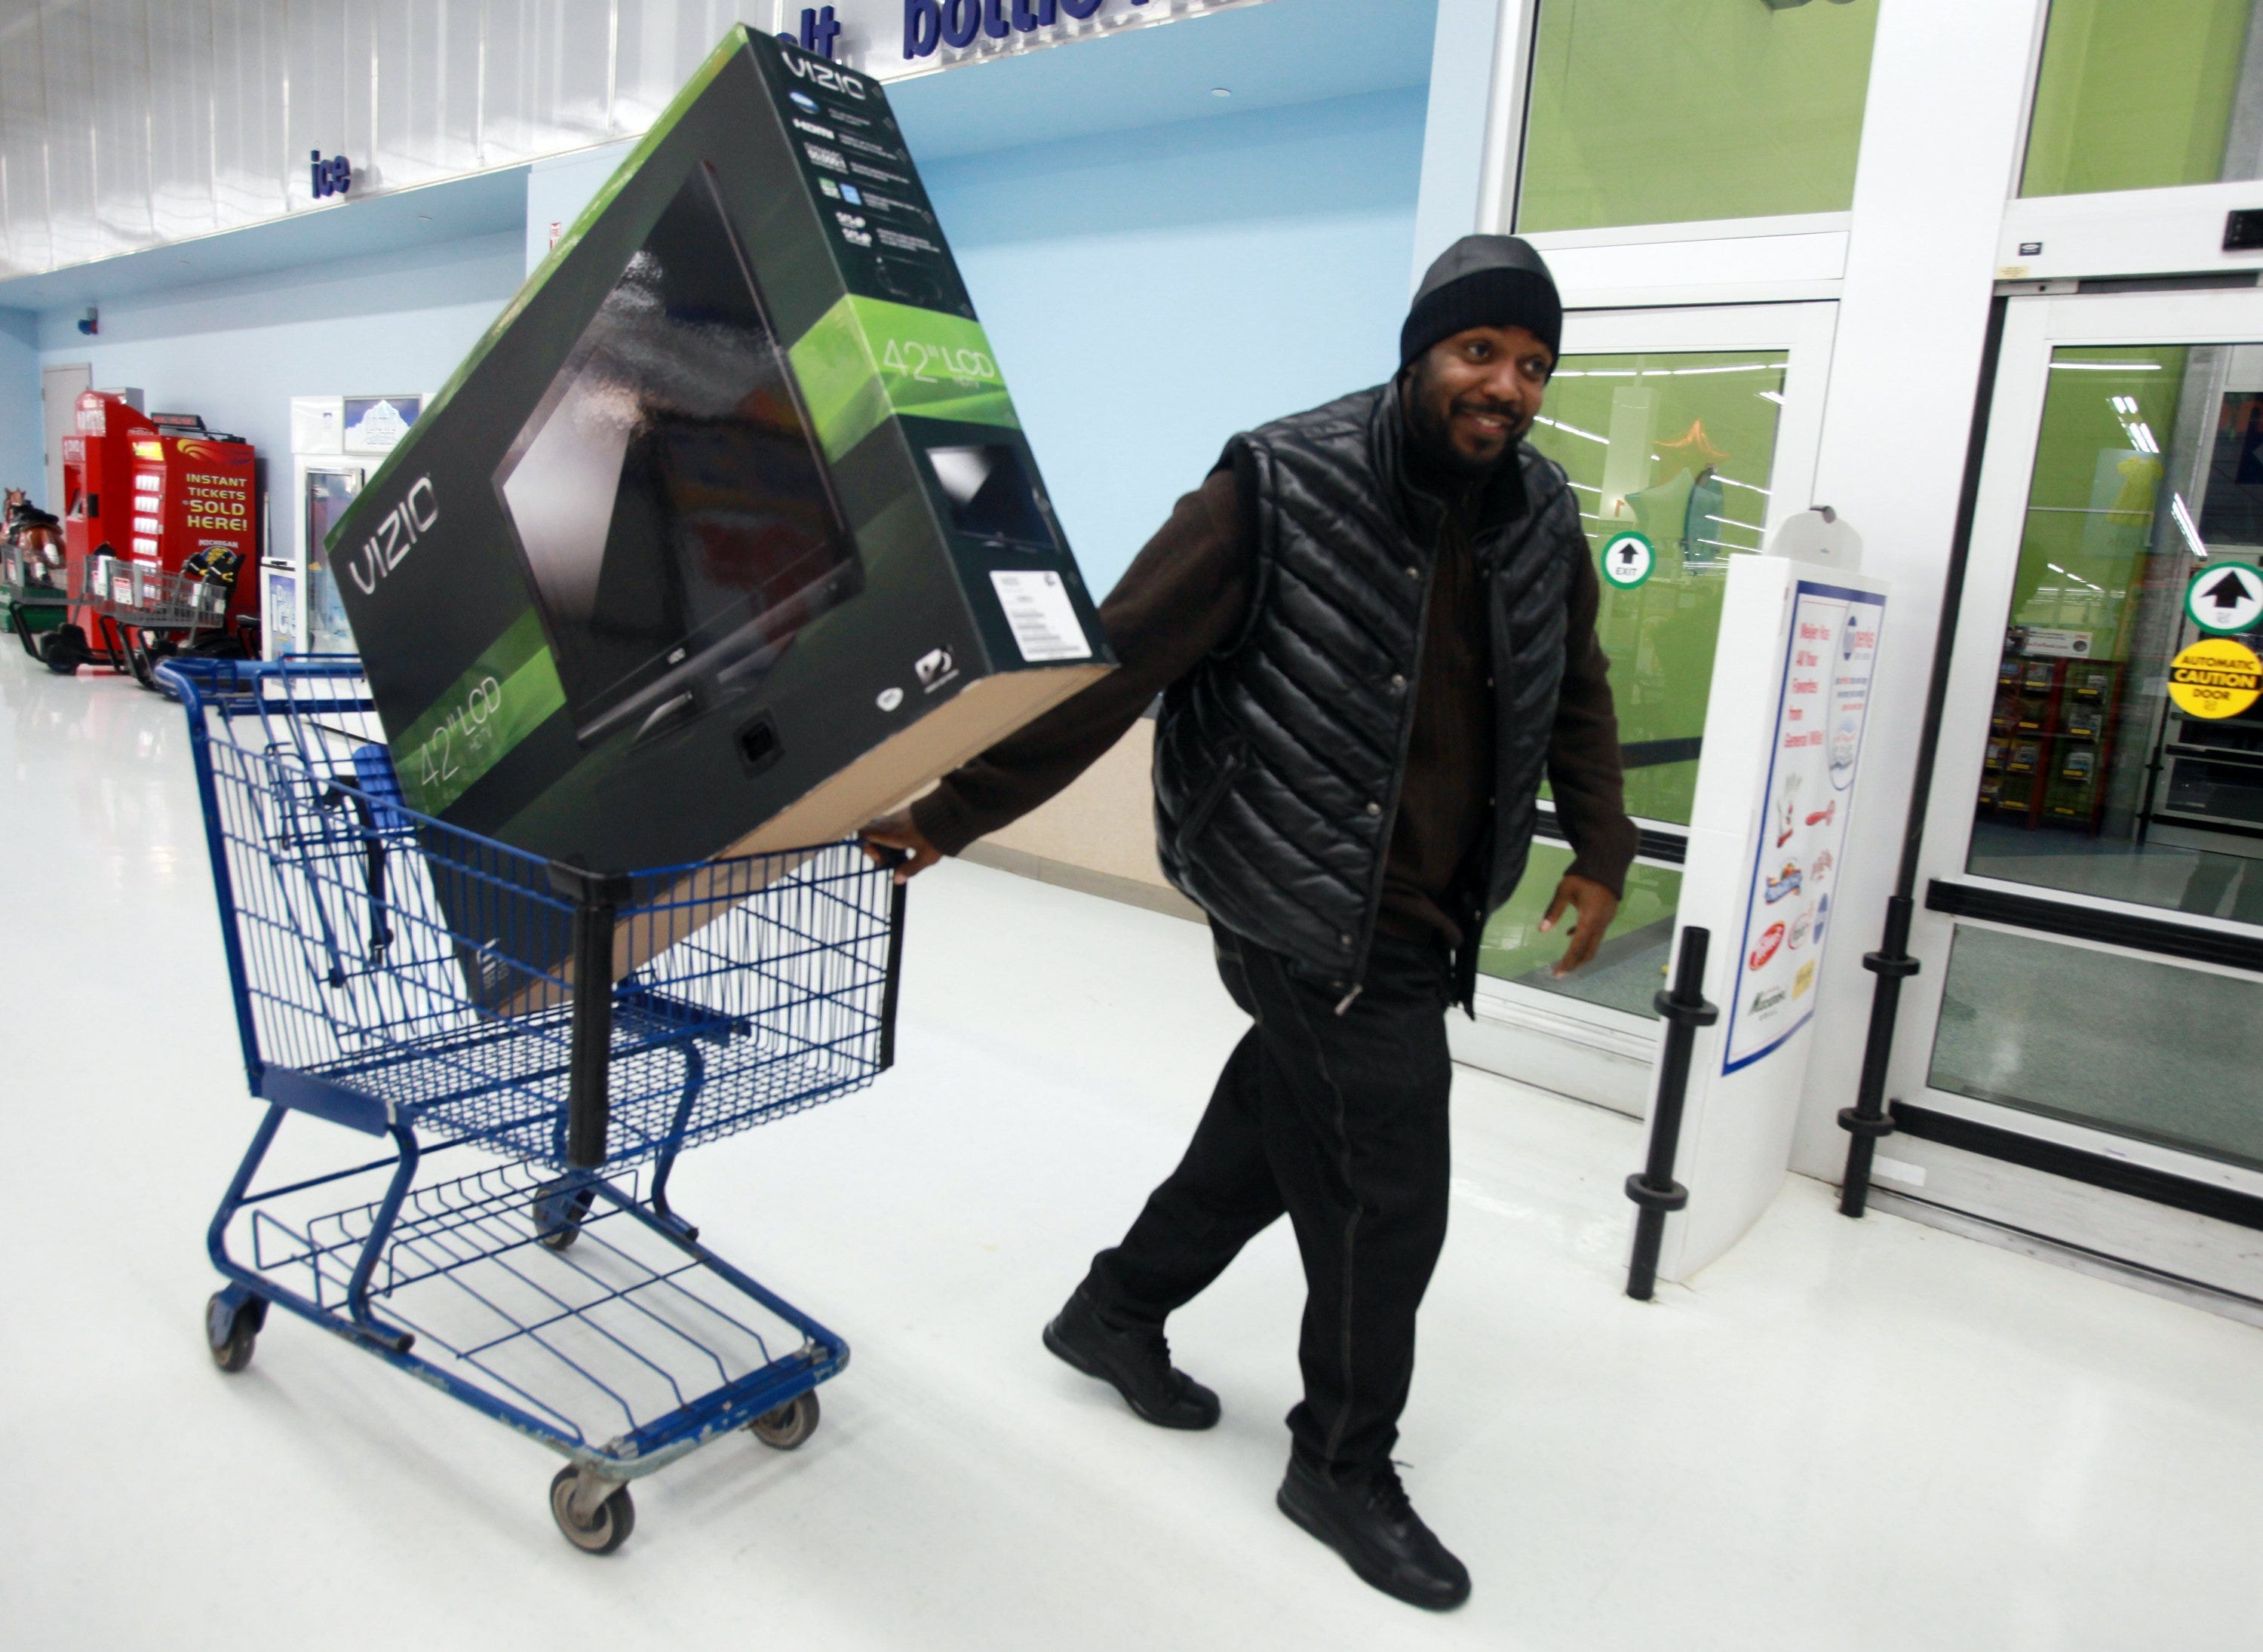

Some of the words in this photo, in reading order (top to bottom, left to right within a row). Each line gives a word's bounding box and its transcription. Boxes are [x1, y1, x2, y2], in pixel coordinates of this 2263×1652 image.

[781, 51, 866, 100] VIZIO
[311, 149, 351, 199] ice
[186, 474, 247, 487] INSTANT
[188, 487, 246, 501] TICKETS
[189, 499, 245, 516] SOLD
[187, 514, 247, 531] HERE!
[349, 477, 439, 595] VIZIO
[1616, 567, 1637, 576] EXIT
[2182, 655, 2255, 671] AUTOMATIC
[2174, 669, 2258, 689] CAUTION
[2193, 688, 2231, 701] DOOR
